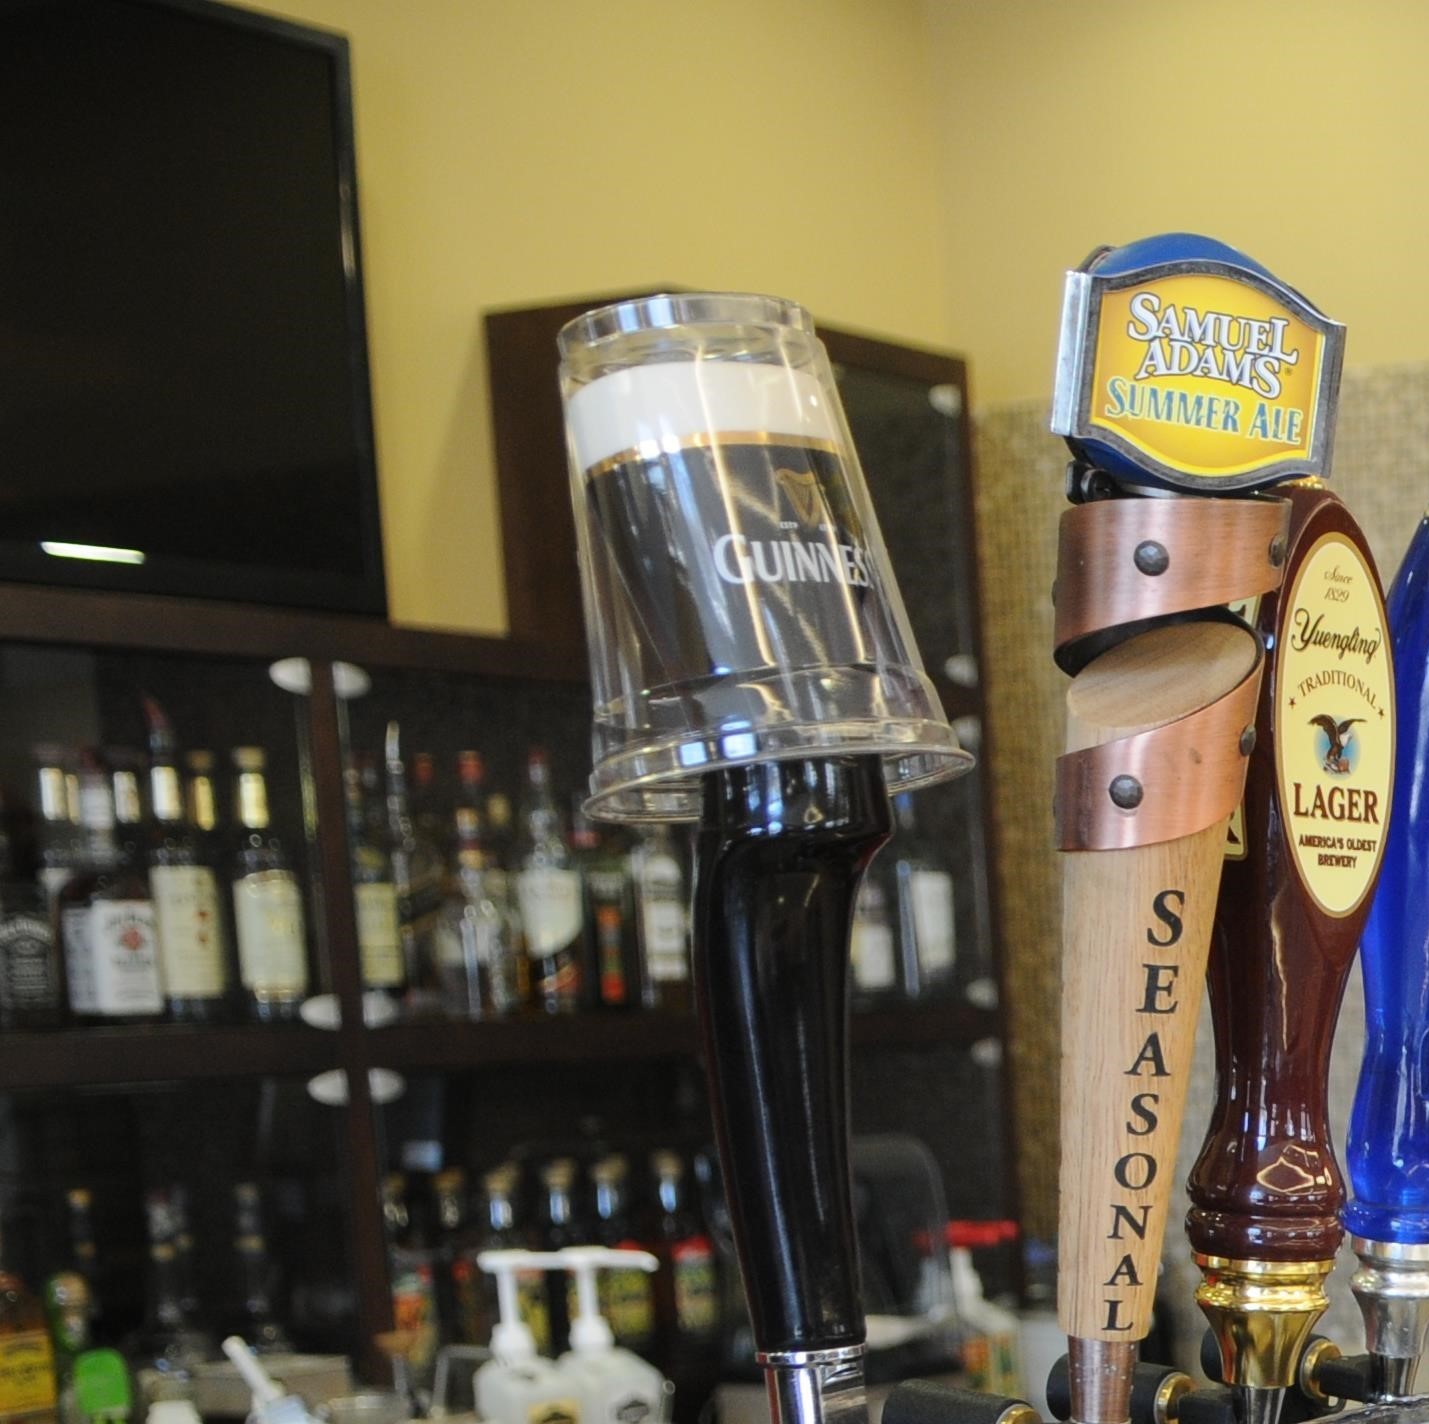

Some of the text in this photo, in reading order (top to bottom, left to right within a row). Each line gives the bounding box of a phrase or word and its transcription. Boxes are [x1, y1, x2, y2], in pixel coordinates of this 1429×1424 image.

[1127, 292, 1298, 364] SAMUEL
[1134, 337, 1281, 400] ADAMS
[1105, 376, 1304, 445] SUMMER ALE
[1324, 565, 1353, 584] Since
[1324, 588, 1349, 602] 1829
[1291, 608, 1381, 665] Yuengling
[1298, 669, 1380, 710] TRADITIONAL
[1293, 783, 1379, 825] LAGER
[1299, 834, 1376, 853] AMERICA'S OLDEST
[1318, 854, 1357, 869] BREWERY
[1101, 888, 1186, 1332] SEASONAL
